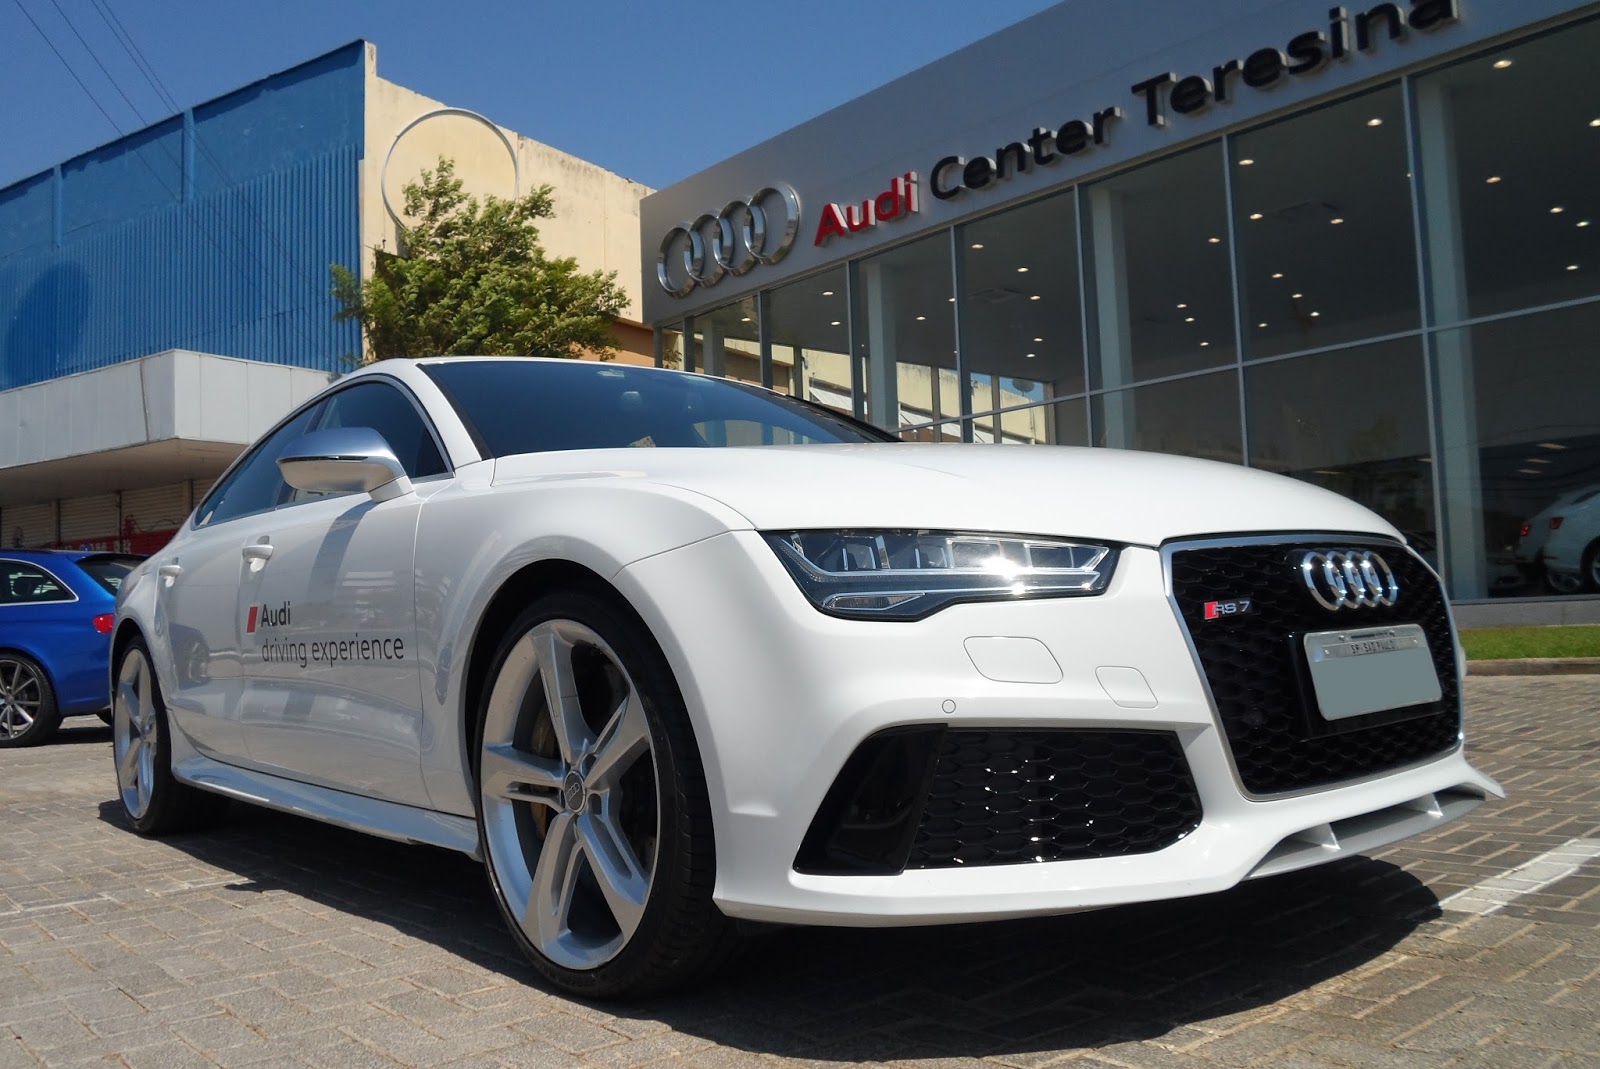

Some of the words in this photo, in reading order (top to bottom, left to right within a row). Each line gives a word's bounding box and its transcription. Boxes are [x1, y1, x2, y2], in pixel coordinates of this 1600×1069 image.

[814, 171, 919, 247] Audi
[930, 106, 1122, 201] Center
[1131, 0, 1459, 127] Teresina
[260, 601, 291, 627] Audi
[262, 637, 307, 668] driving
[312, 632, 404, 668] experience
